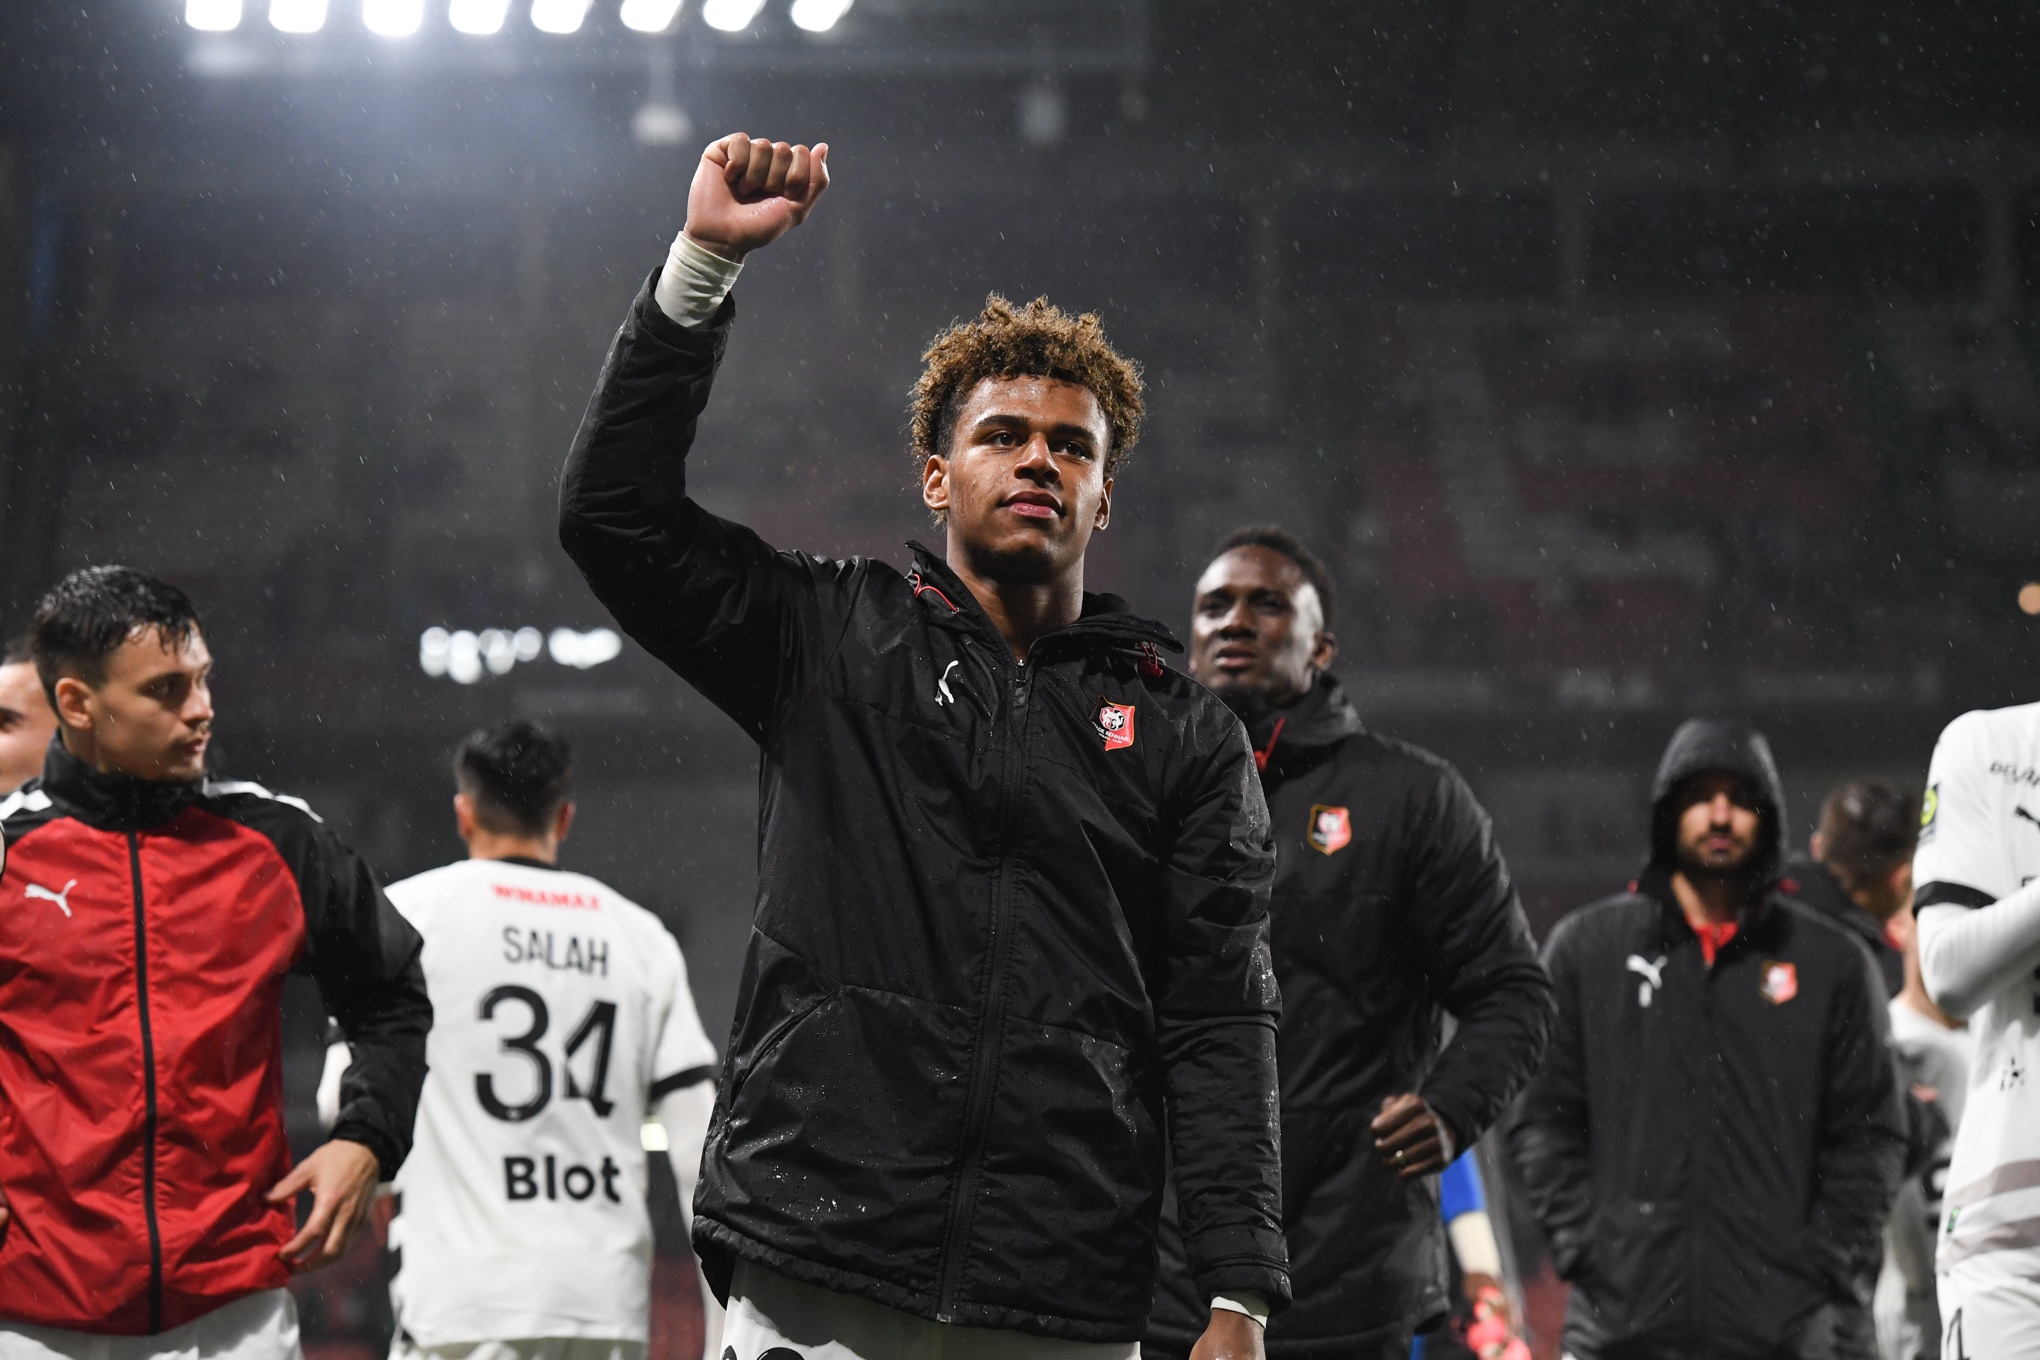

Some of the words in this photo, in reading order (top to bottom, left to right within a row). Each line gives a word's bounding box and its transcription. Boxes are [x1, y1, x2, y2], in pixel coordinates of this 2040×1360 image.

[502, 925, 609, 978] SALAH
[475, 984, 618, 1122] 34
[503, 1155, 622, 1204] Blot
